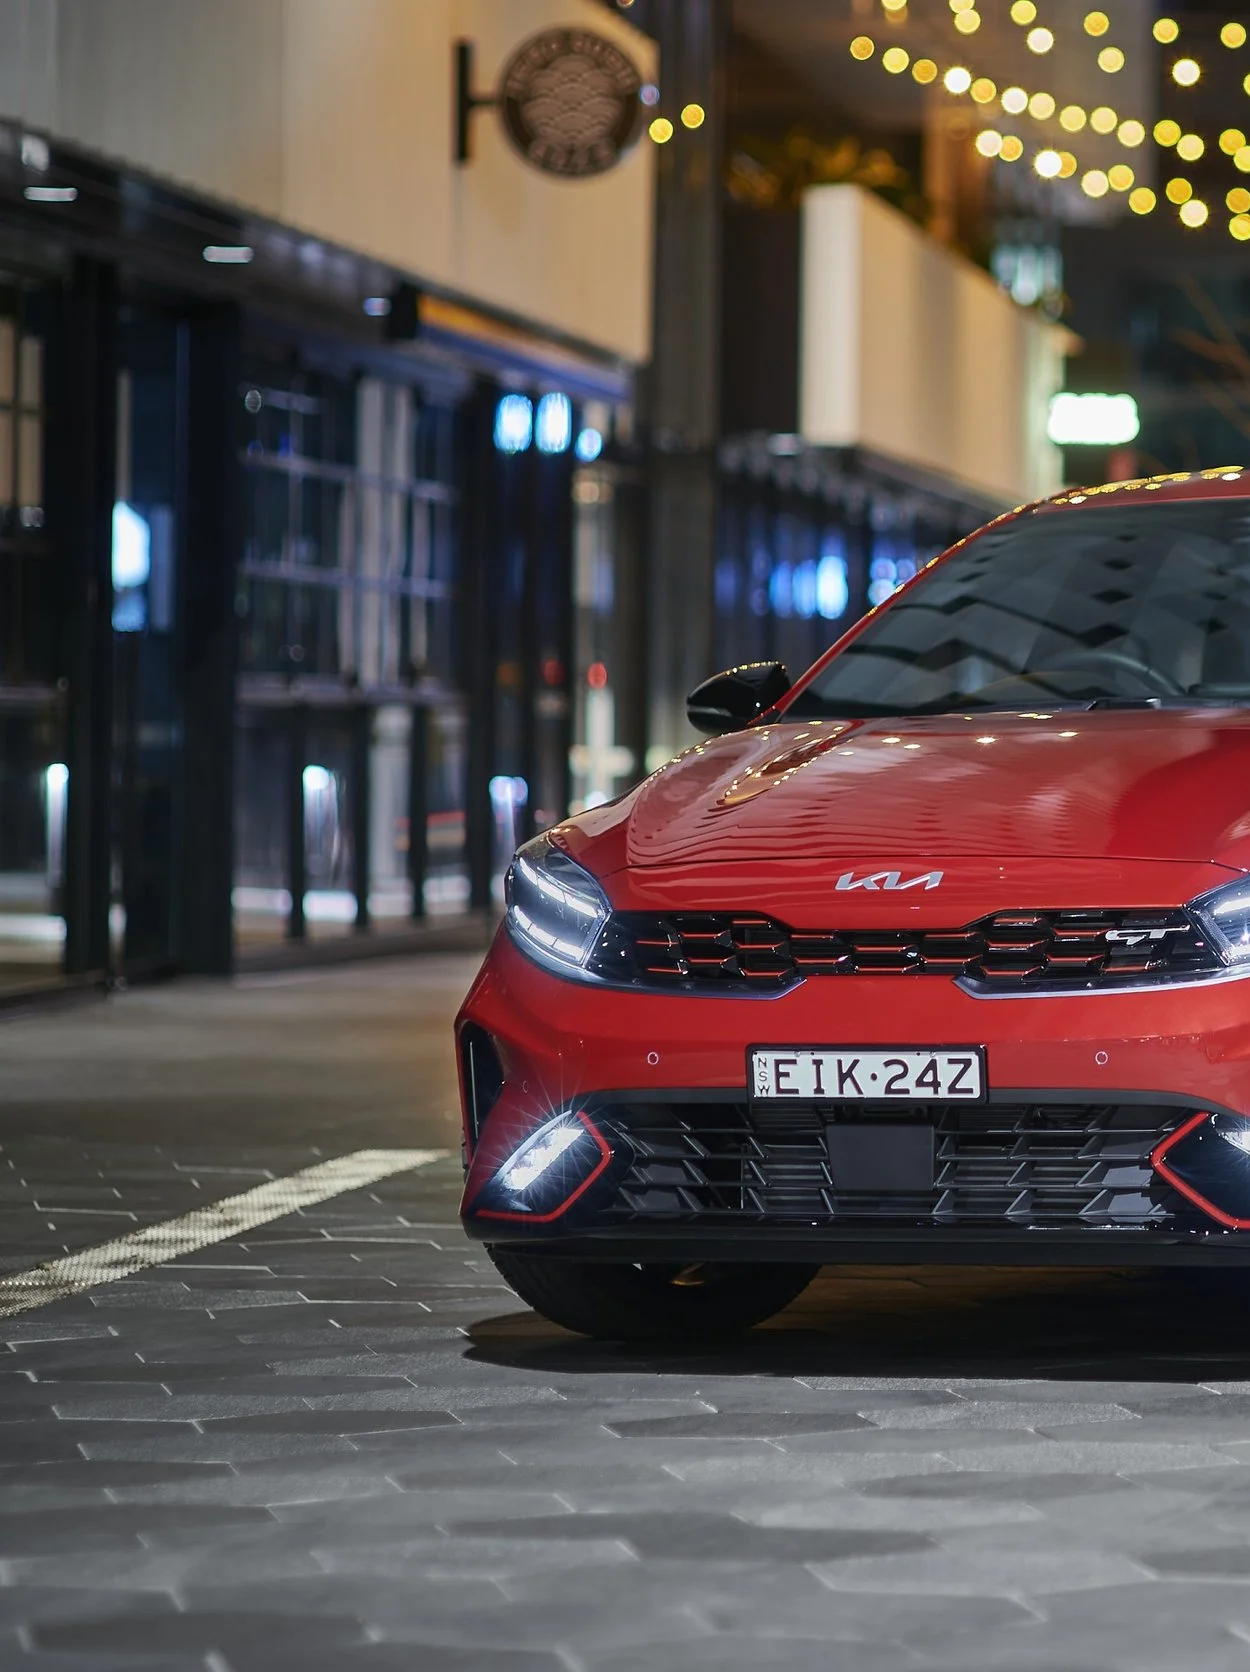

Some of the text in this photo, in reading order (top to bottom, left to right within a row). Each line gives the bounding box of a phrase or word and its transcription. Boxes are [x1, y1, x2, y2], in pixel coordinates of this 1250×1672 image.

[835, 871, 944, 890] KIA
[1105, 925, 1190, 945] GT
[757, 1057, 771, 1096] NSW
